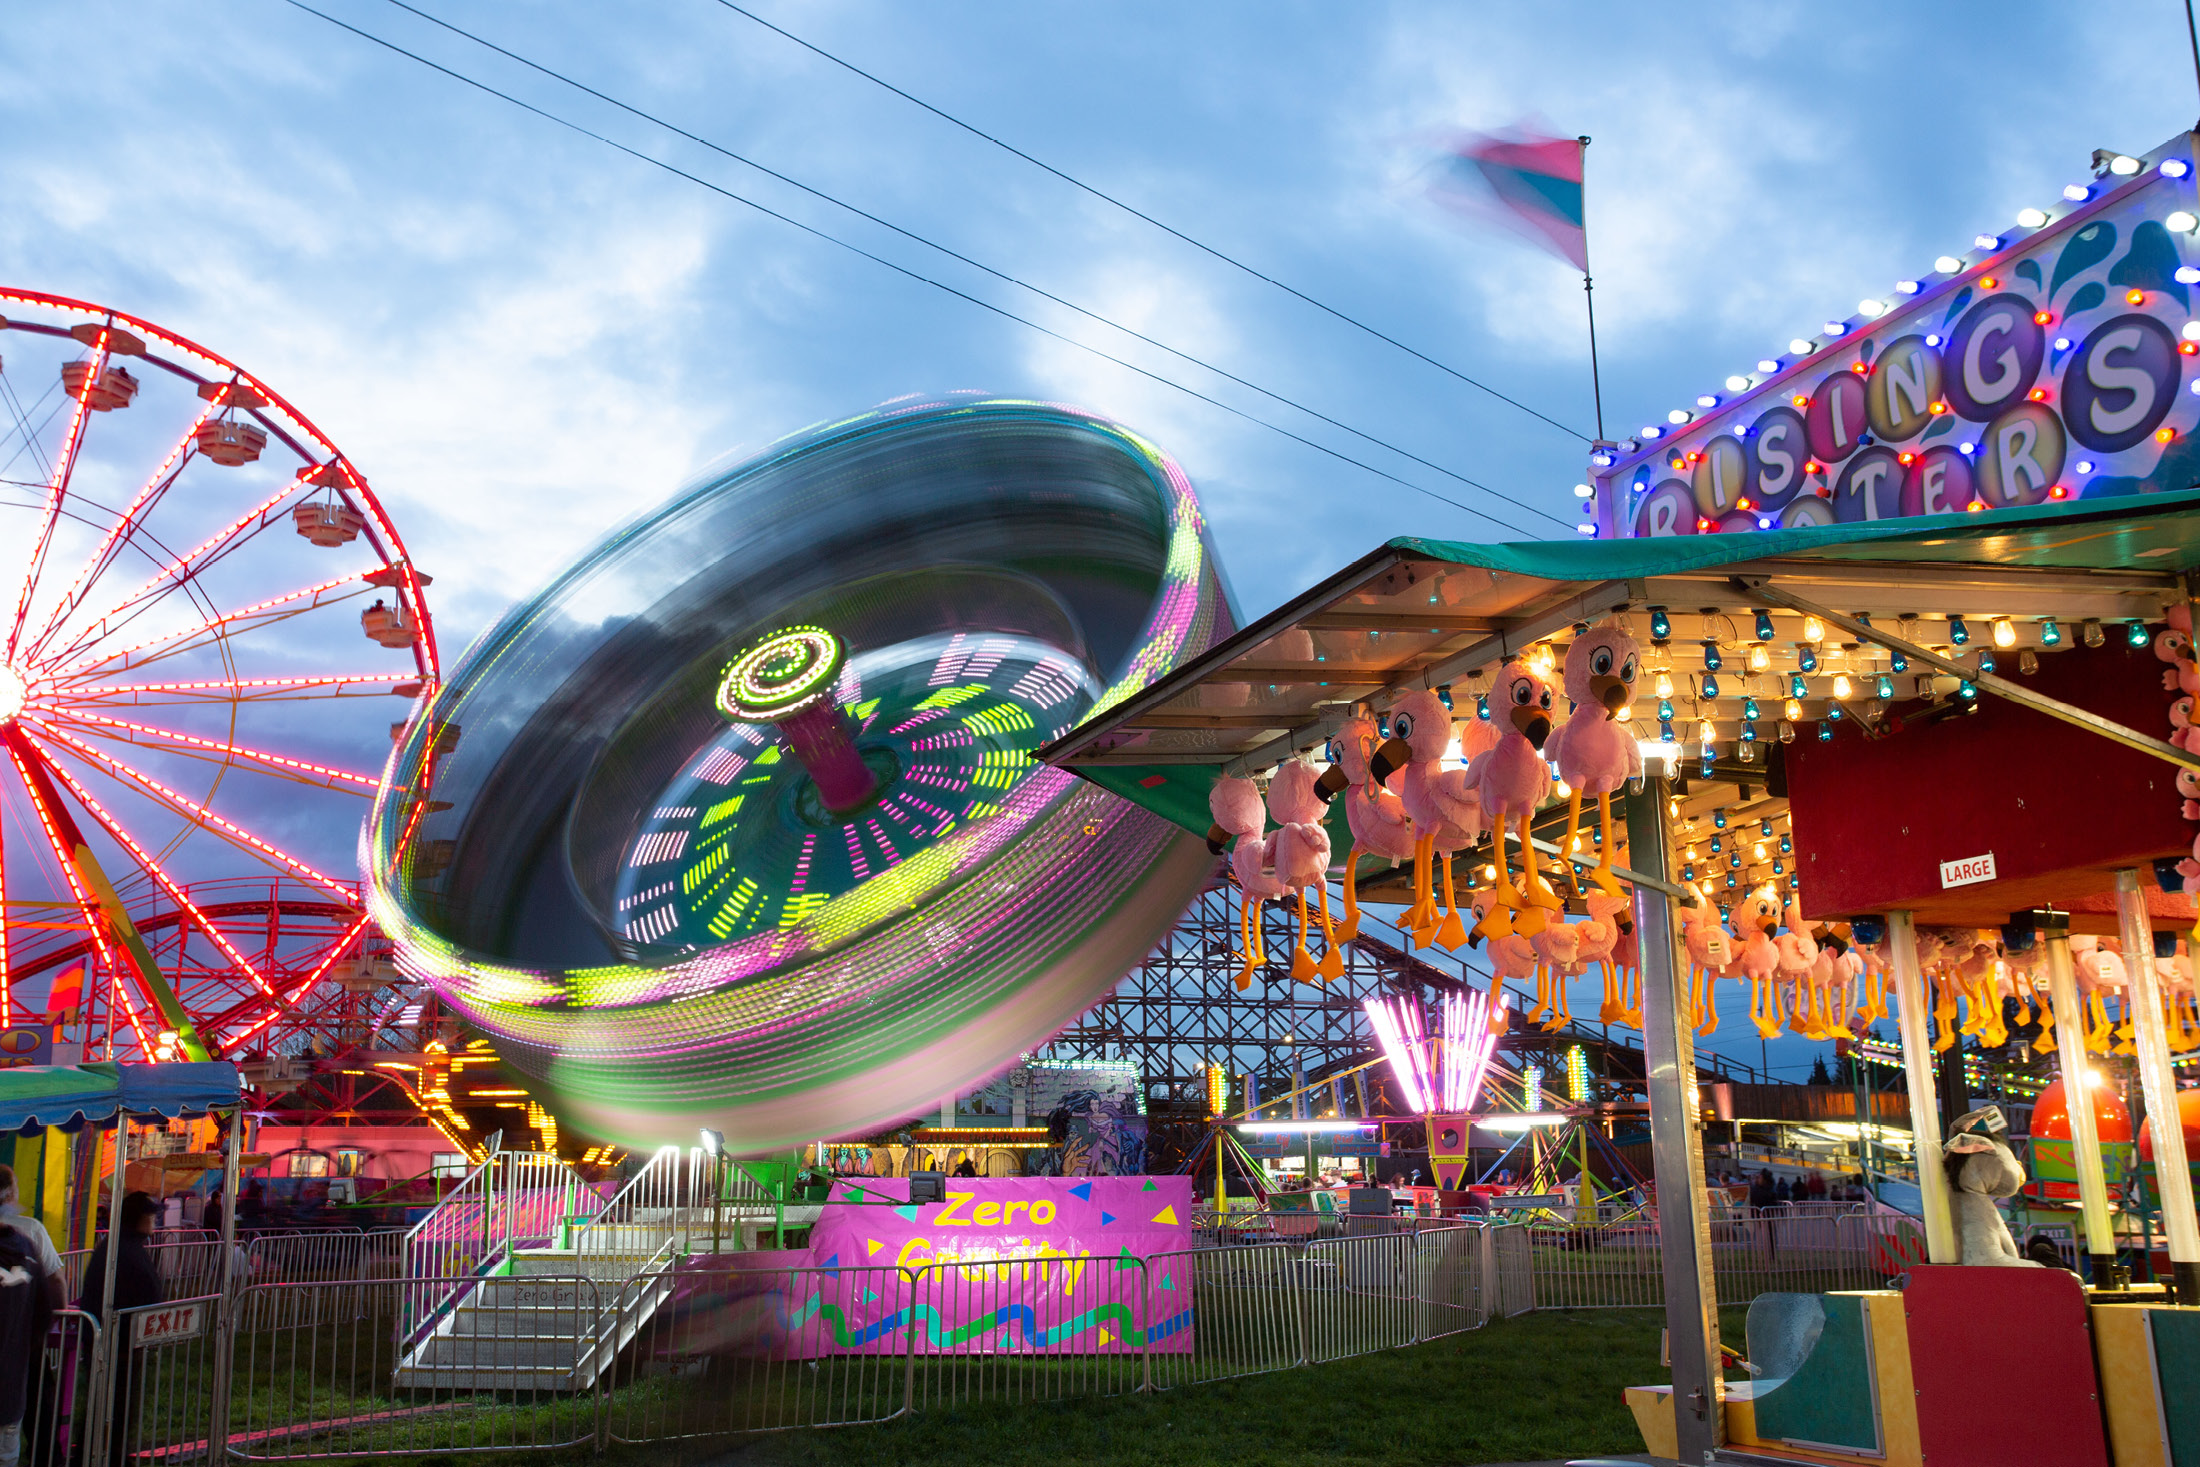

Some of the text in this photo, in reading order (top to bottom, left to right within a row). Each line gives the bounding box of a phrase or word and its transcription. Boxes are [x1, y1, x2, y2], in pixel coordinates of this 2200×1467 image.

[1650, 312, 2022, 537] RISING
[1945, 859, 1991, 883] LARGE
[933, 1192, 1057, 1227] Zero
[2039, 1229, 2066, 1238] EXIT
[896, 1237, 1090, 1296] Gravity
[514, 1287, 621, 1302] Zero Grav
[143, 1308, 194, 1339] EXIT
